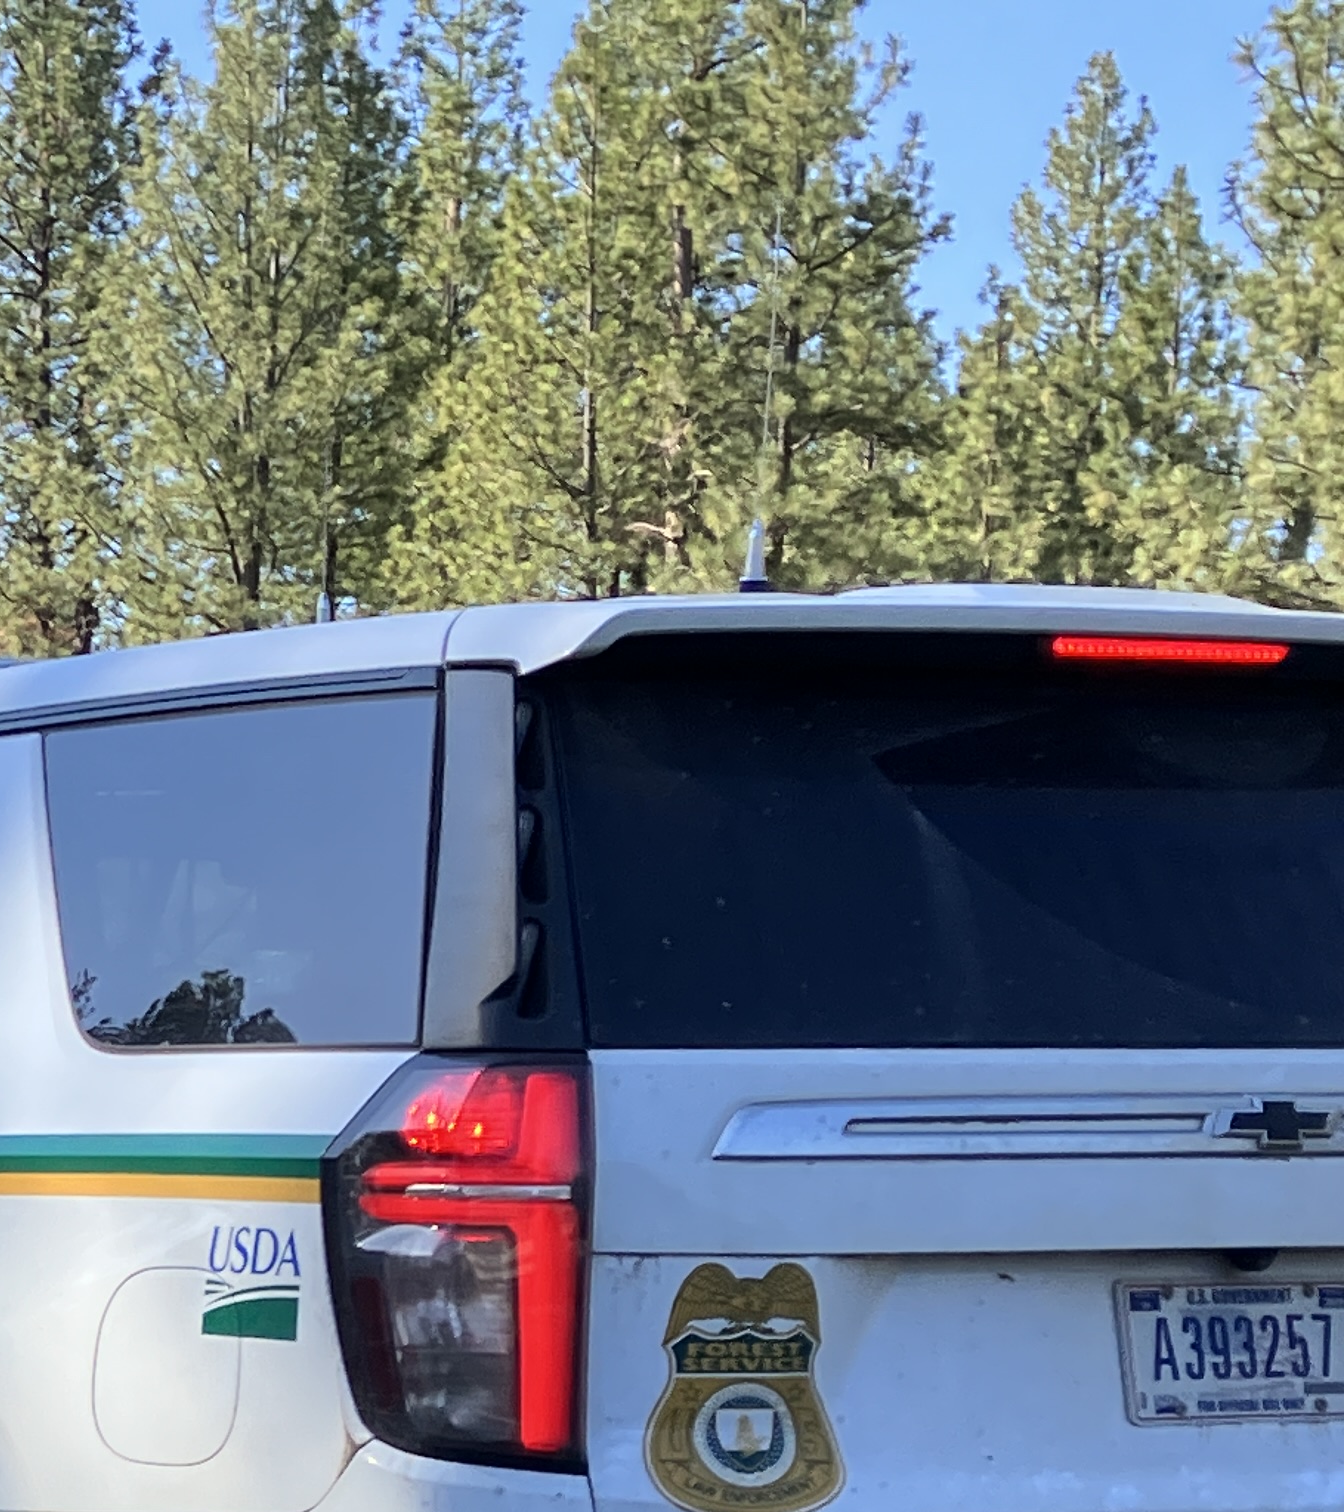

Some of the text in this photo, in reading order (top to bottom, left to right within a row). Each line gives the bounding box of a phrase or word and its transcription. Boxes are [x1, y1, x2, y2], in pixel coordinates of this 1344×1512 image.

[208, 1225, 301, 1277] USDA
[682, 1357, 805, 1371] SERVICE
[686, 1342, 805, 1358] FOREST
[1153, 1313, 1332, 1381] A393257
